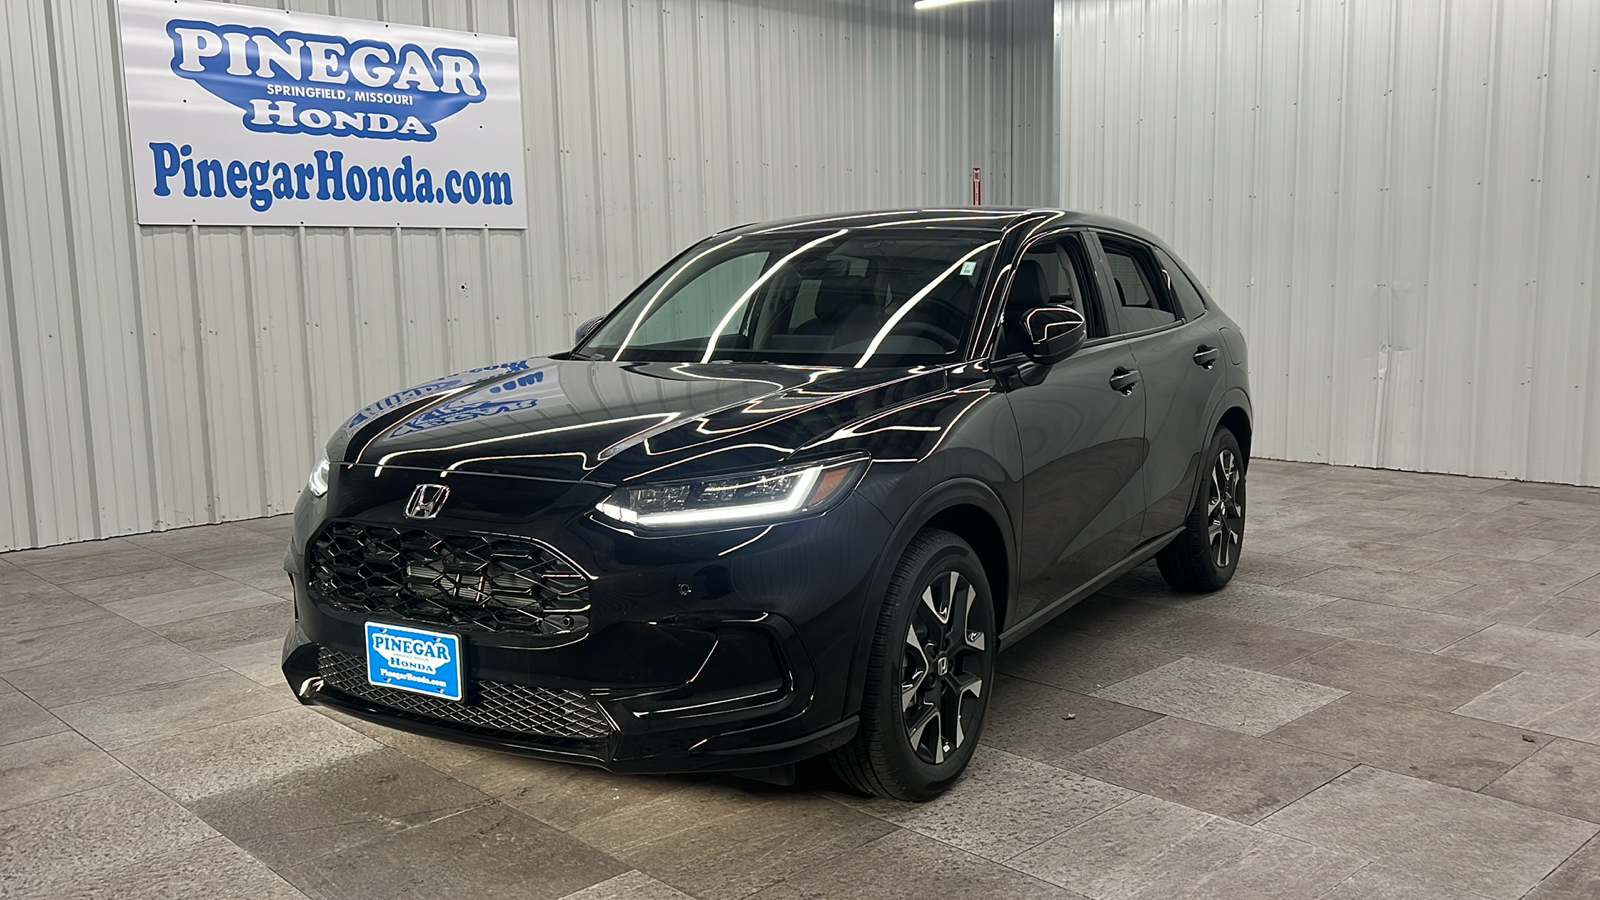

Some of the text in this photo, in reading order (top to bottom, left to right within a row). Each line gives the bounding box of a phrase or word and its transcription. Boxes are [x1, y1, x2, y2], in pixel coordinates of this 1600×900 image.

[174, 28, 481, 96] PINEGAR
[267, 84, 413, 106] SPRINGFIELD, MISSOURI
[149, 142, 513, 212] PinegarHonda.com
[375, 636, 448, 660] PINEGAR
[380, 668, 447, 688] PinegarHonda.com
